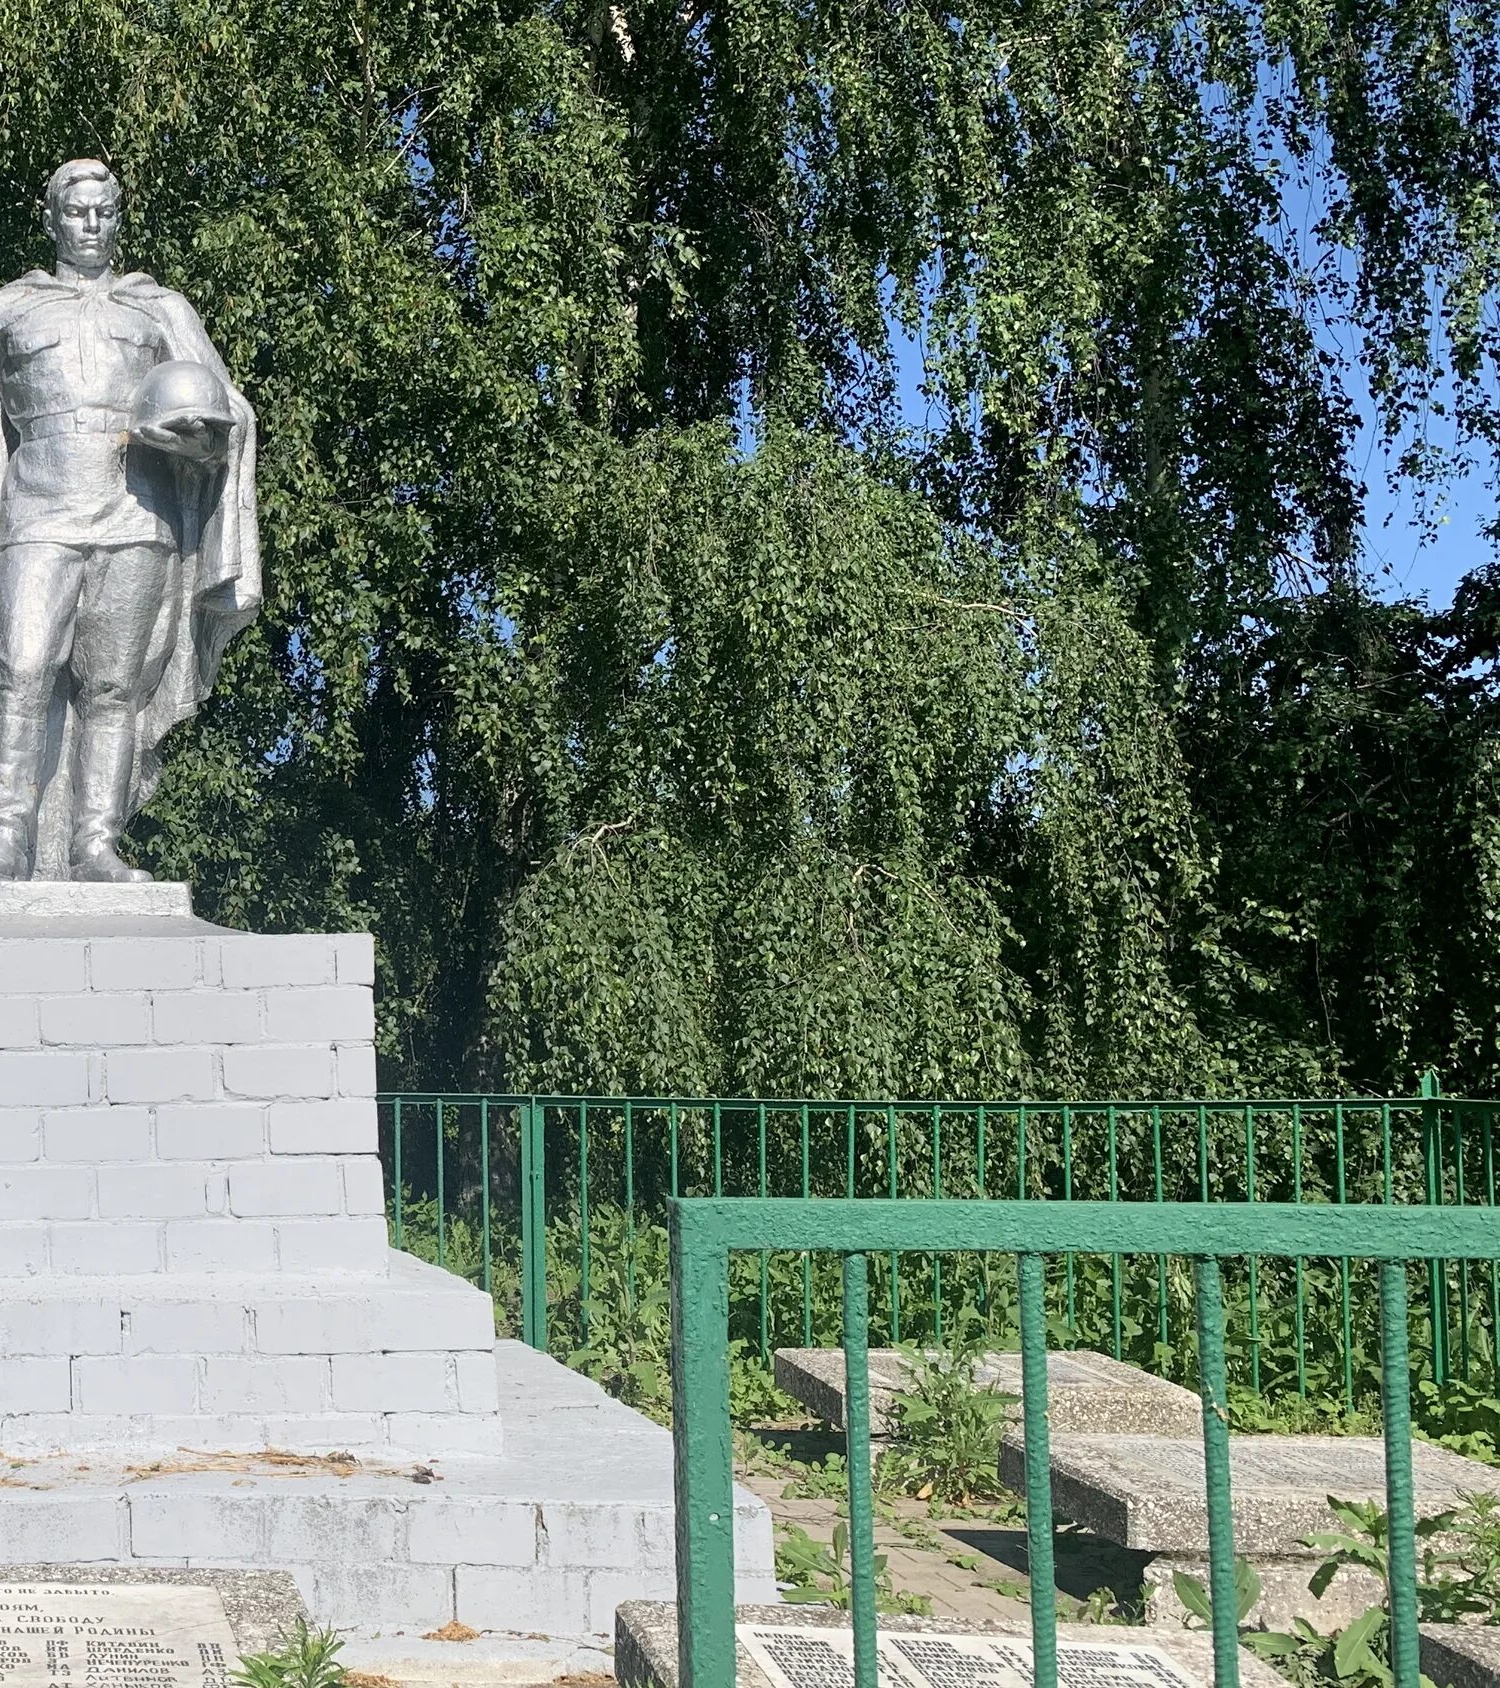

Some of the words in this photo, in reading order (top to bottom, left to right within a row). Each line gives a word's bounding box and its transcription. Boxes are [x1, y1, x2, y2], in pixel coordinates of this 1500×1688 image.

[17, 1615, 105, 1624] СВОБОДУ
[1, 1625, 65, 1635] НАШЕЙ
[74, 1626, 156, 1636] РОДИНЫ
[85, 1666, 172, 1675] ДАНИЛОВ
